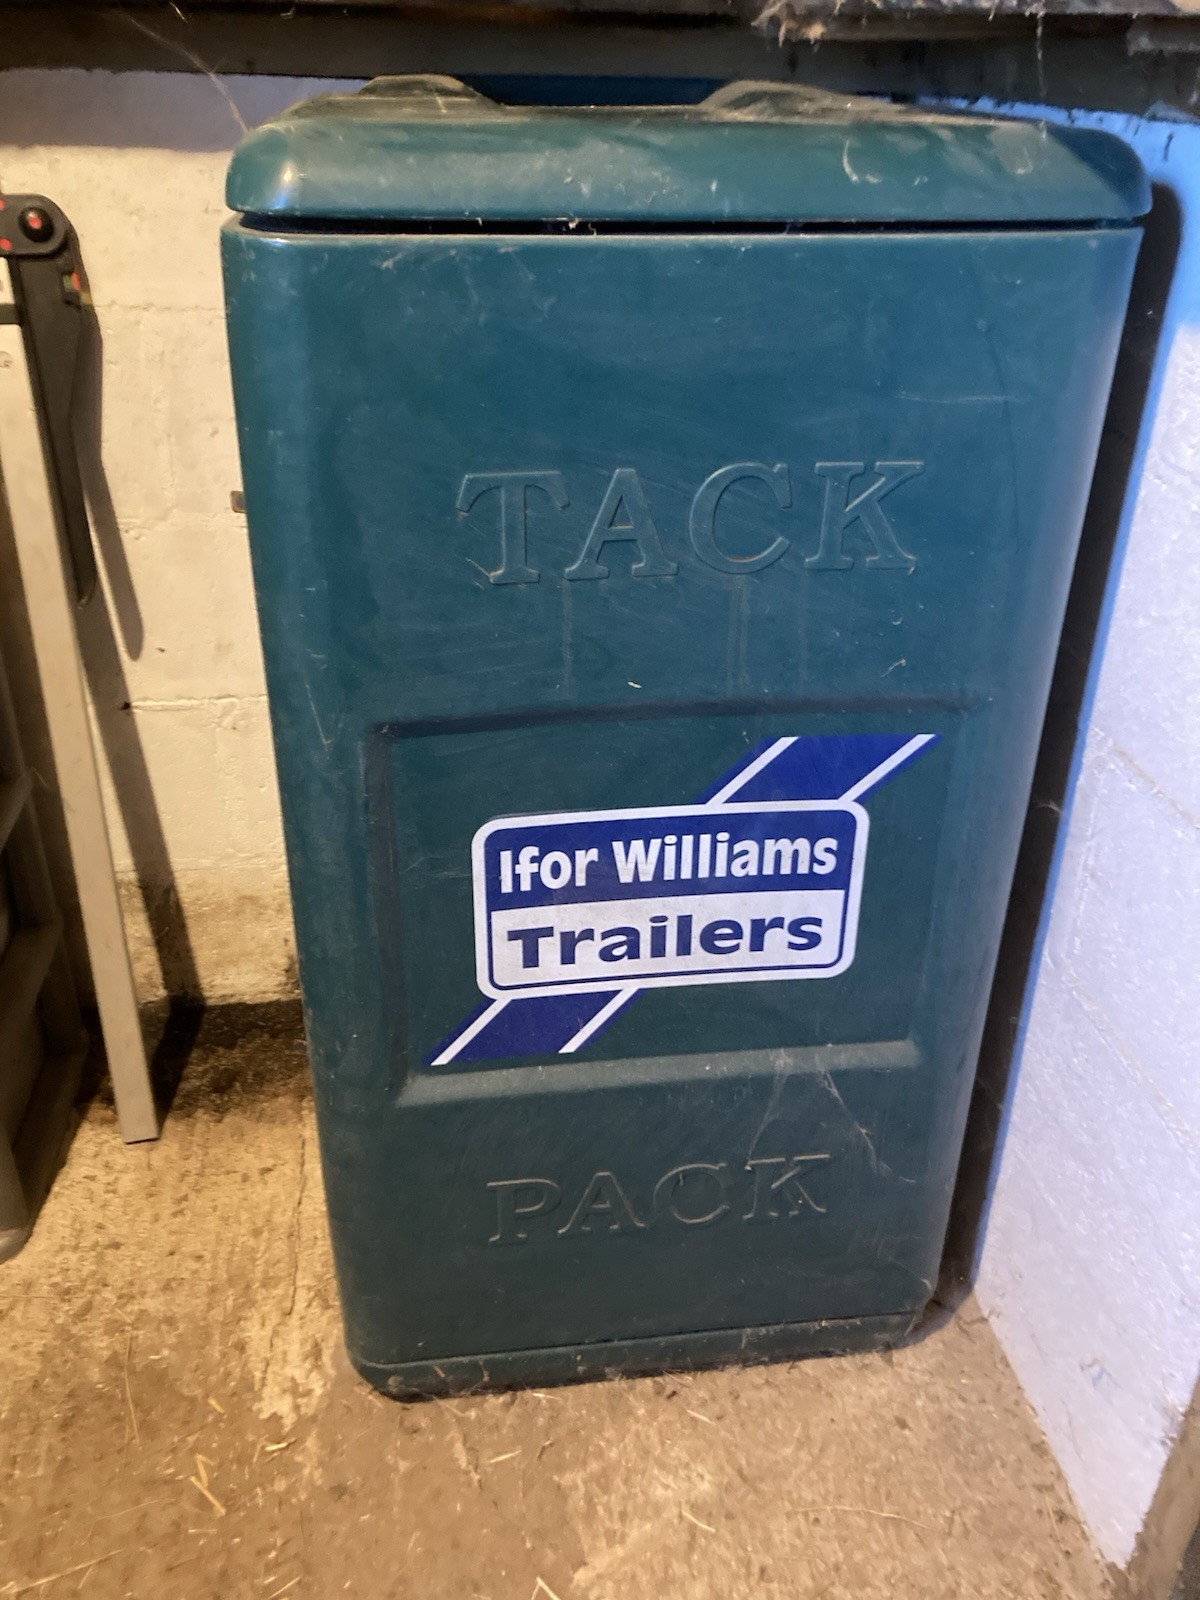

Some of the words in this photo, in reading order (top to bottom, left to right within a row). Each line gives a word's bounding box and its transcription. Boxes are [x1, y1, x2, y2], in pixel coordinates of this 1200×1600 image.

[456, 461, 925, 585] TACK
[500, 844, 599, 893] Ifor
[611, 832, 839, 883] Williams
[507, 914, 823, 969] Trailers
[486, 1153, 831, 1244] PACK
